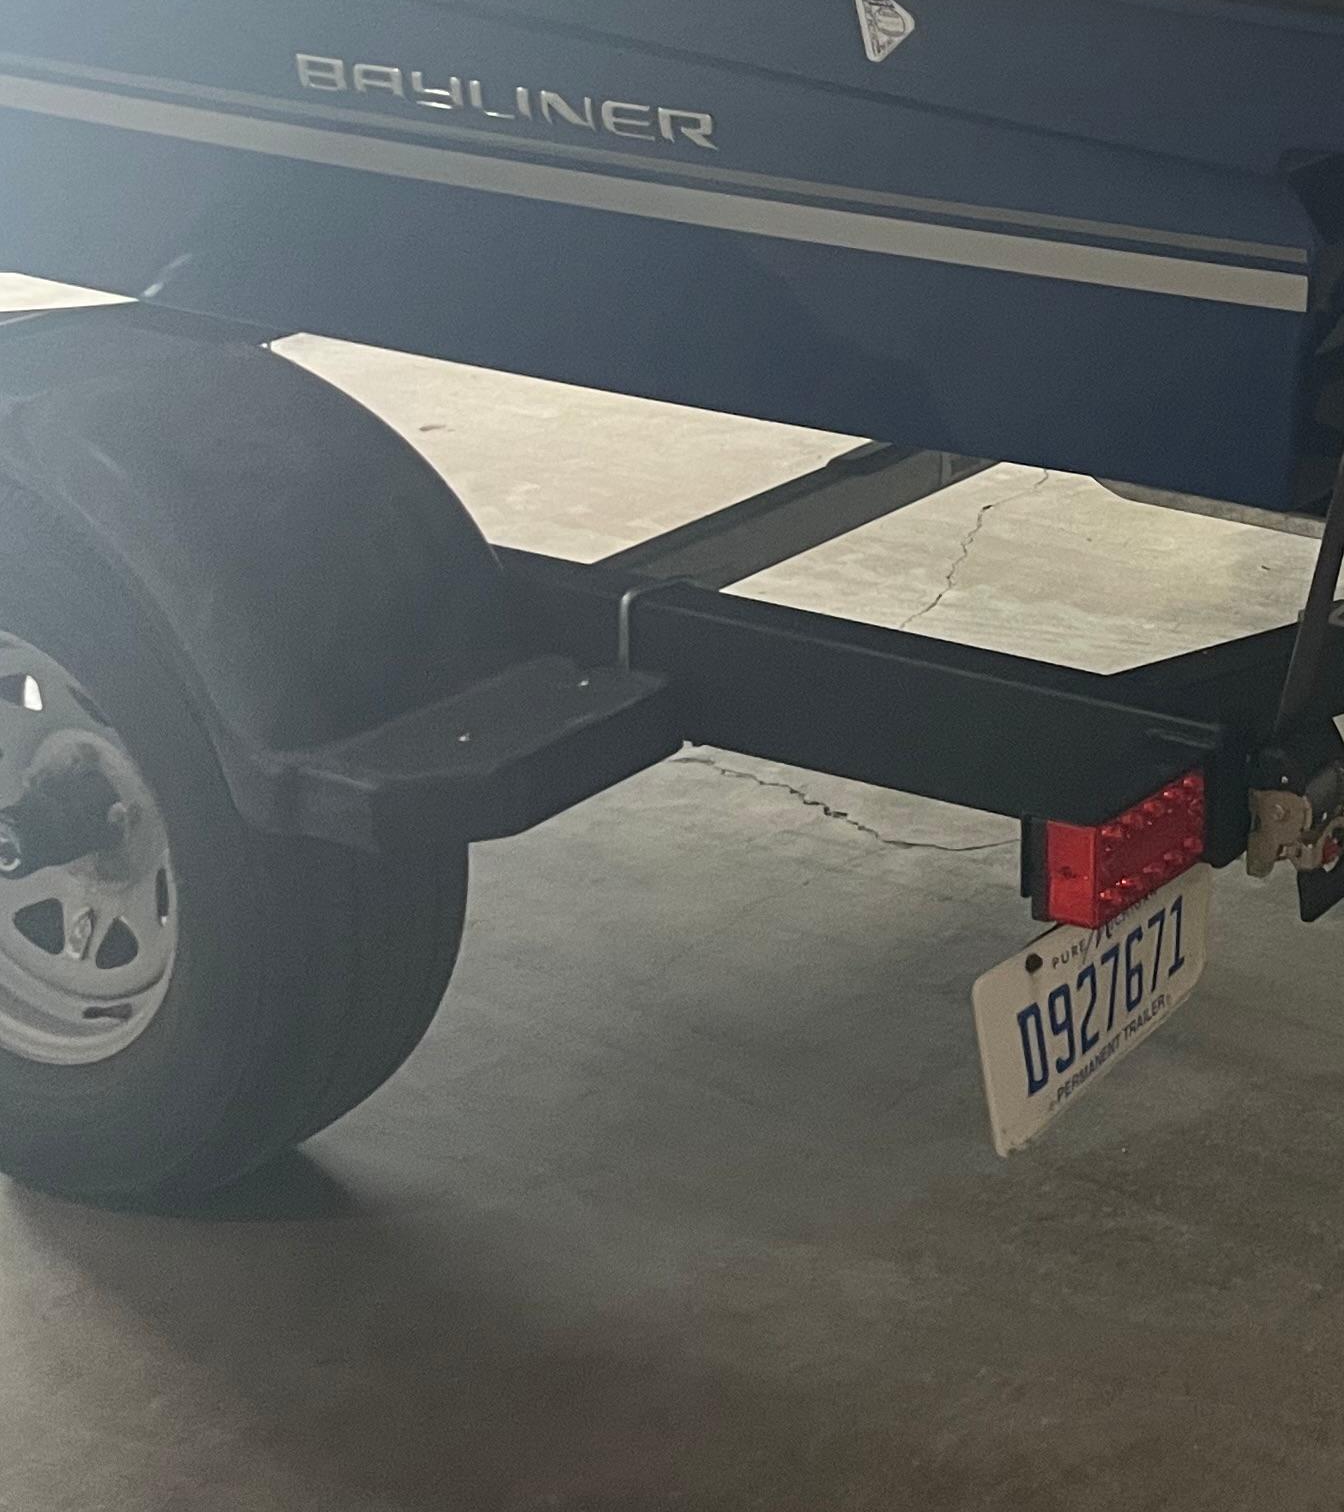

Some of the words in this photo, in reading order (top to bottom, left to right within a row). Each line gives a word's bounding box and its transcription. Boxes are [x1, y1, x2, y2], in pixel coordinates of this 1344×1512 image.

[296, 53, 719, 151] BAYLINER
[1016, 895, 1186, 1097] D927671
[1052, 939, 1086, 968] PURE
[1056, 1034, 1121, 1102] PERMANENT
[1122, 994, 1165, 1039] TRAILER
